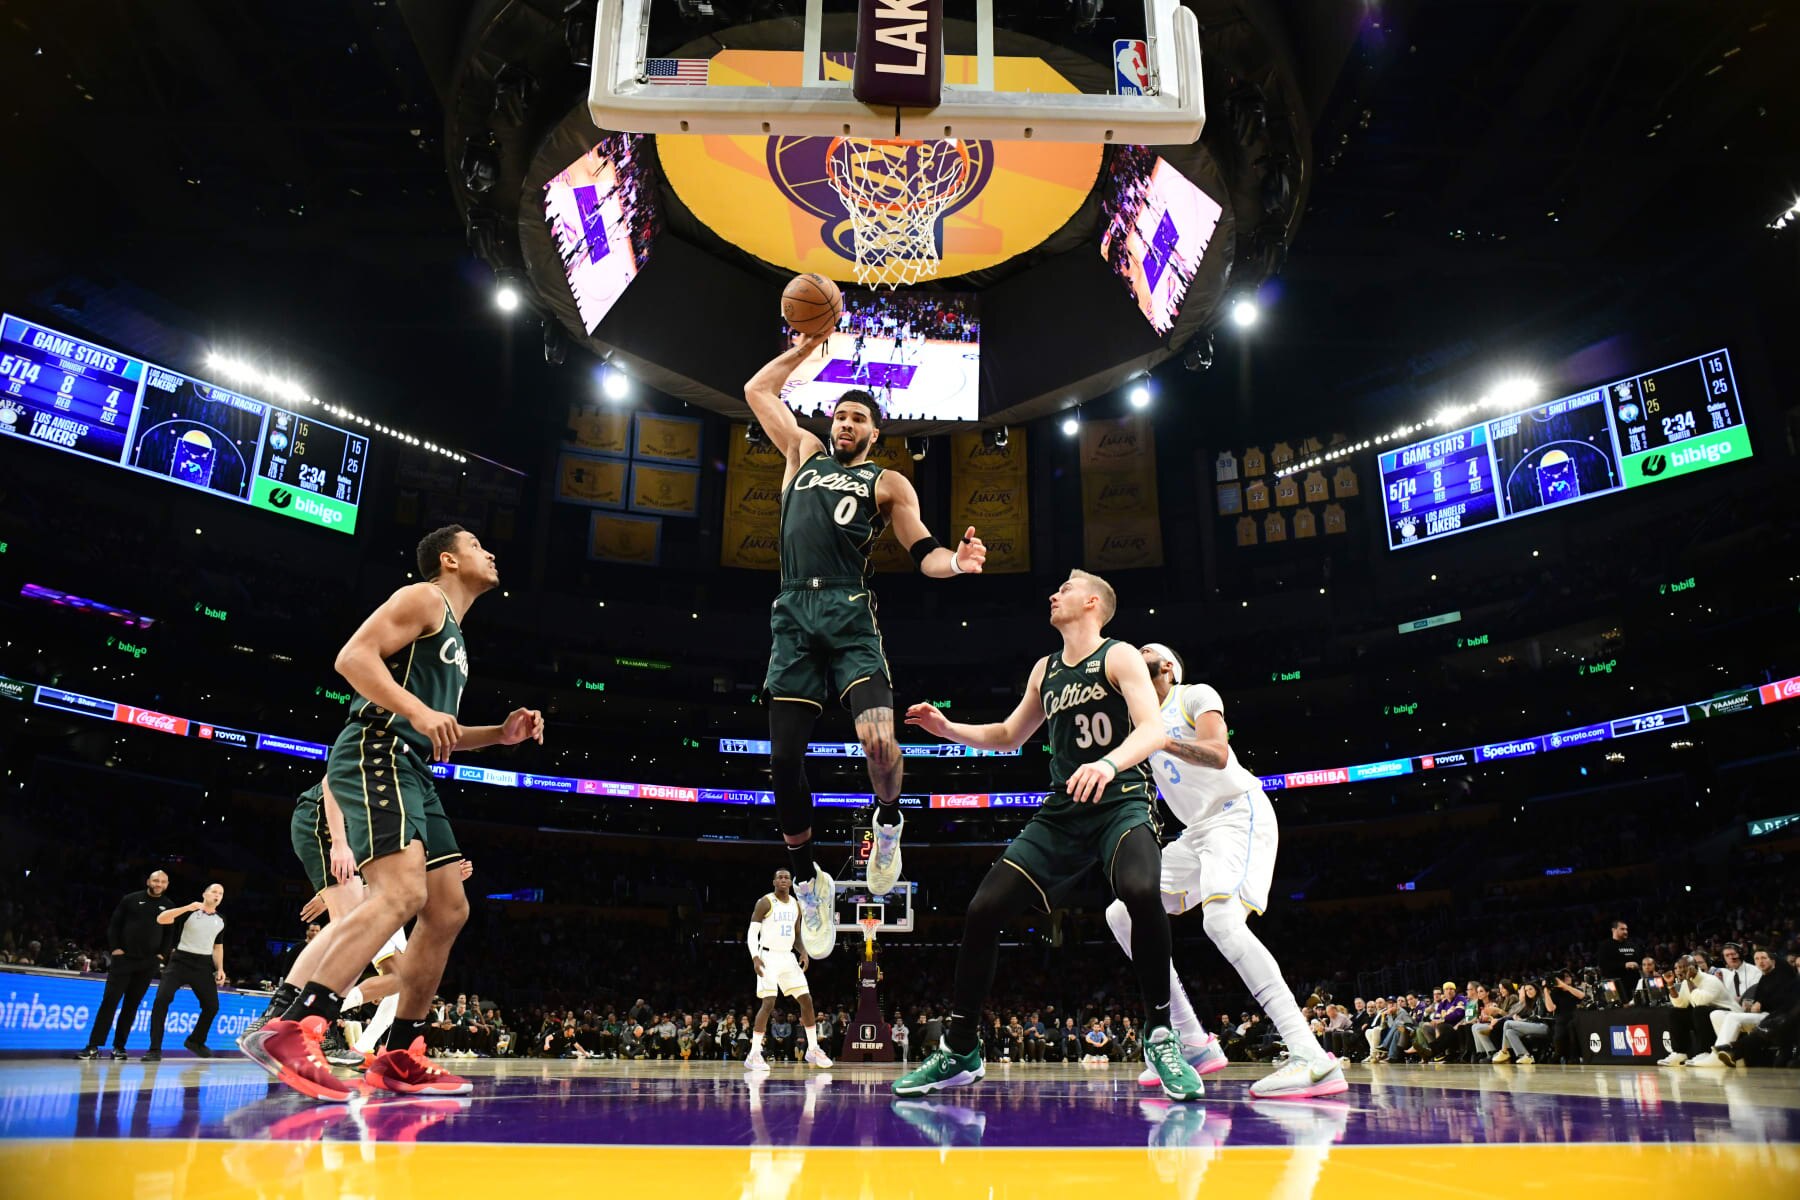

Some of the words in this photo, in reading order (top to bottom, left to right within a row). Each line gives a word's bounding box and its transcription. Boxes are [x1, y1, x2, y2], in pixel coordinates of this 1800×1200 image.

[33, 331, 76, 358] GAME
[75, 345, 118, 373] STATS
[0, 355, 41, 383] 5/14
[1708, 357, 1723, 373] 15
[9, 382, 21, 393] FG
[60, 375, 75, 394] 8
[147, 376, 177, 393] LAKERS
[1643, 379, 1656, 393] 15
[1712, 378, 1728, 395] 25
[106, 390, 120, 409] 4
[211, 390, 231, 404] SHOT
[230, 395, 262, 414] TRACKER
[1549, 401, 1566, 415] SHOT
[1567, 391, 1600, 409] TRACKER
[1646, 398, 1660, 414] 25
[33, 411, 52, 425] LOS
[51, 416, 89, 436] ANGELES
[101, 414, 116, 424] AST
[1661, 411, 1696, 435] 2:34
[30, 423, 78, 447] LAKERS
[299, 422, 308, 437] 15
[1492, 424, 1518, 440] LAKERS
[294, 441, 305, 455] 25
[351, 440, 361, 454] 15
[745, 444, 783, 455] LAKER
[1403, 444, 1431, 466] GAME
[1433, 435, 1464, 457] STATS
[1671, 441, 1732, 467] bibigo
[299, 464, 326, 486] 2:34
[1468, 460, 1478, 477] 4
[794, 469, 870, 498] Celtics
[1433, 471, 1442, 488] 8
[743, 488, 782, 504] LAKER
[968, 490, 1012, 504] LAKERS
[1389, 478, 1416, 501] 5/14
[295, 496, 342, 524] bibigo
[834, 496, 858, 525] 0
[1425, 511, 1437, 523] LOS
[1438, 503, 1466, 519] ANGELES
[1427, 515, 1461, 536] LAKERS
[740, 535, 781, 552] LAKER
[62, 694, 75, 705] Jay
[1044, 682, 1108, 719] Celtics
[1632, 714, 1665, 730] 7:32
[214, 730, 246, 742] TOYOTA
[1075, 712, 1112, 749] 30
[1562, 728, 1605, 743] crypto.com
[262, 739, 295, 751] AMERICAN
[295, 745, 322, 755] EXPRESS
[813, 746, 837, 754] Lakers
[946, 745, 960, 756] 25
[1483, 741, 1535, 759] Spectrum
[1435, 754, 1465, 764] TOYOTA
[462, 769, 481, 779] UCLA
[486, 772, 514, 784] Health
[1164, 760, 1180, 784] 3
[1288, 770, 1346, 786] TOSHIBA
[534, 778, 571, 789] crypto.com
[1262, 778, 1284, 788] LTRA
[641, 786, 695, 800] TOSHIBA
[728, 792, 754, 801] ULTRA
[1006, 796, 1043, 804] DELTA
[781, 924, 792, 937] 12
